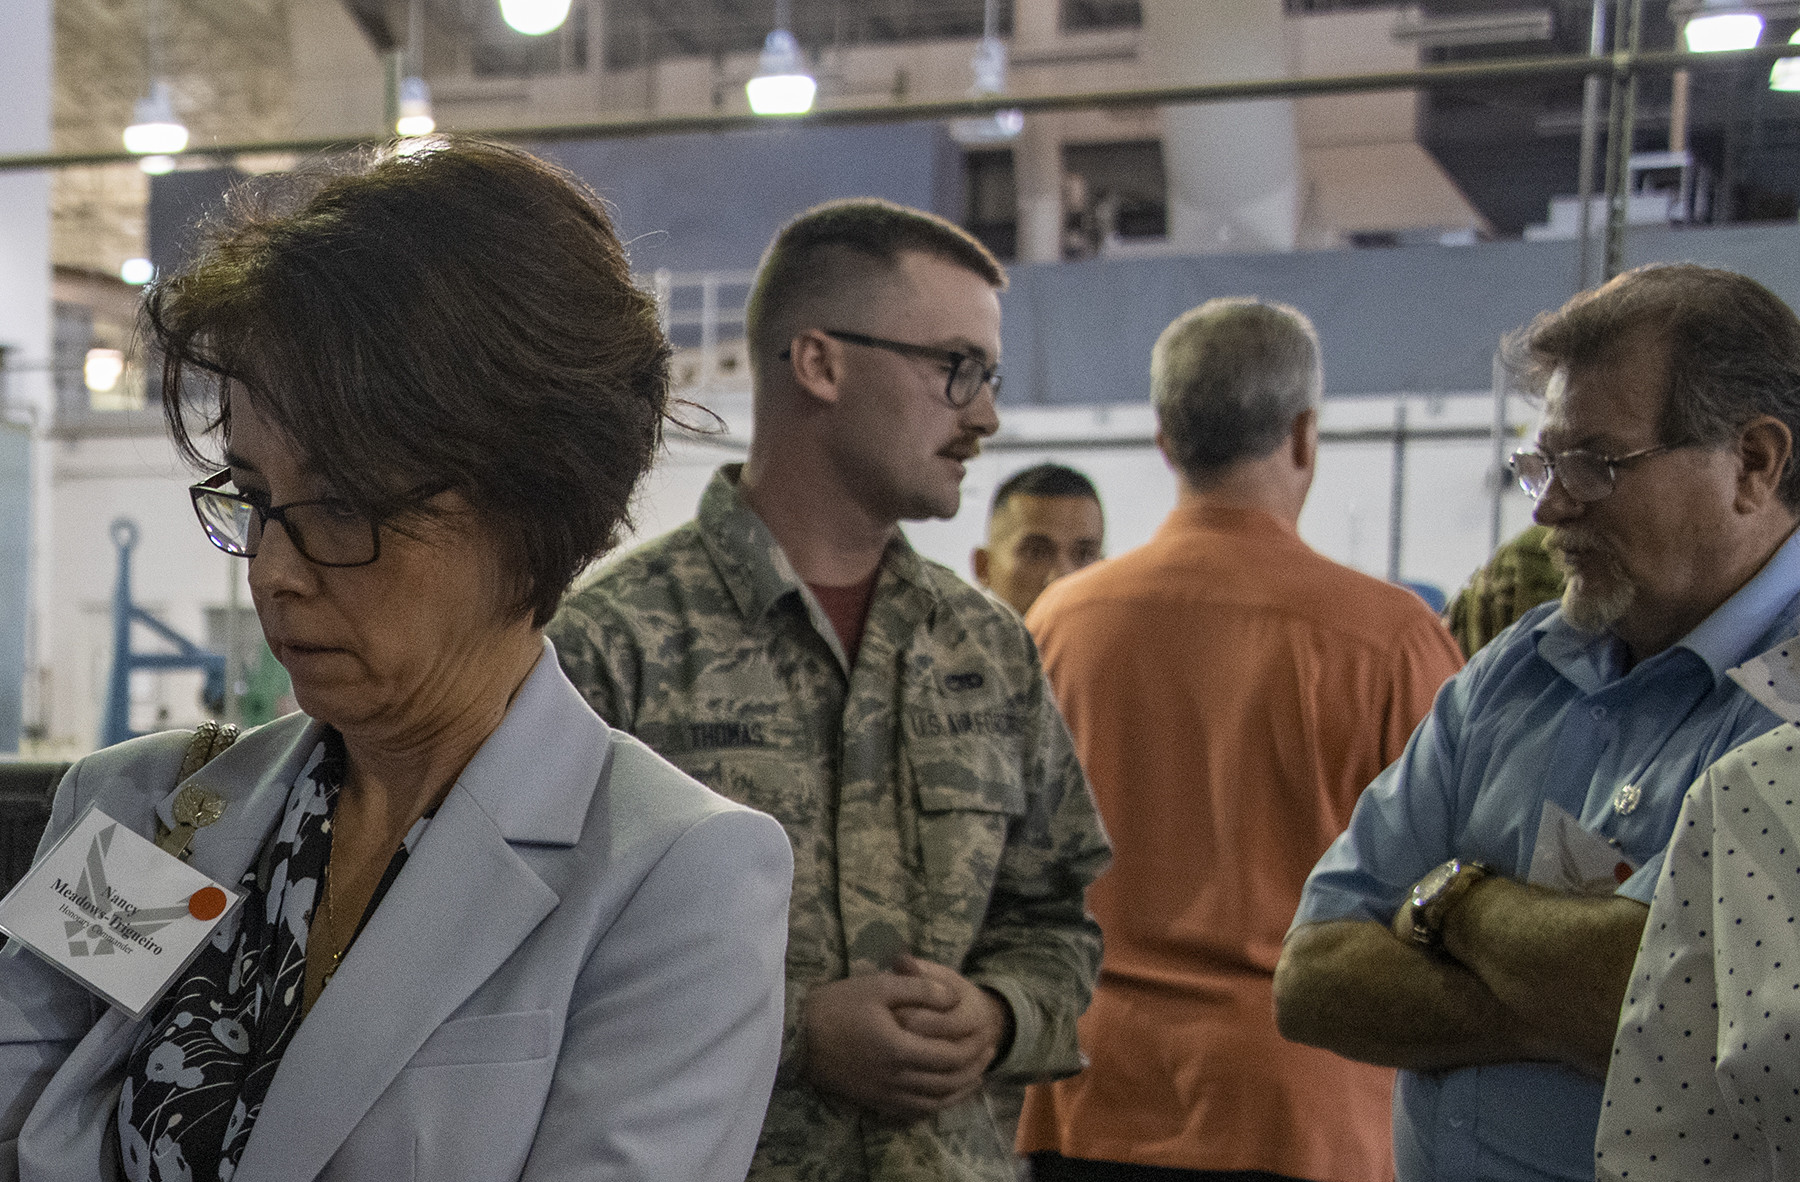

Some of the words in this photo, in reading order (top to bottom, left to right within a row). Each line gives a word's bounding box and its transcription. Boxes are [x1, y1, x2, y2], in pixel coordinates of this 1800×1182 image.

[50, 878, 162, 955] Meadows-Trigueiro
[101, 886, 140, 917] Nancy
[58, 903, 91, 928] Honorary
[91, 924, 134, 954] Commander
